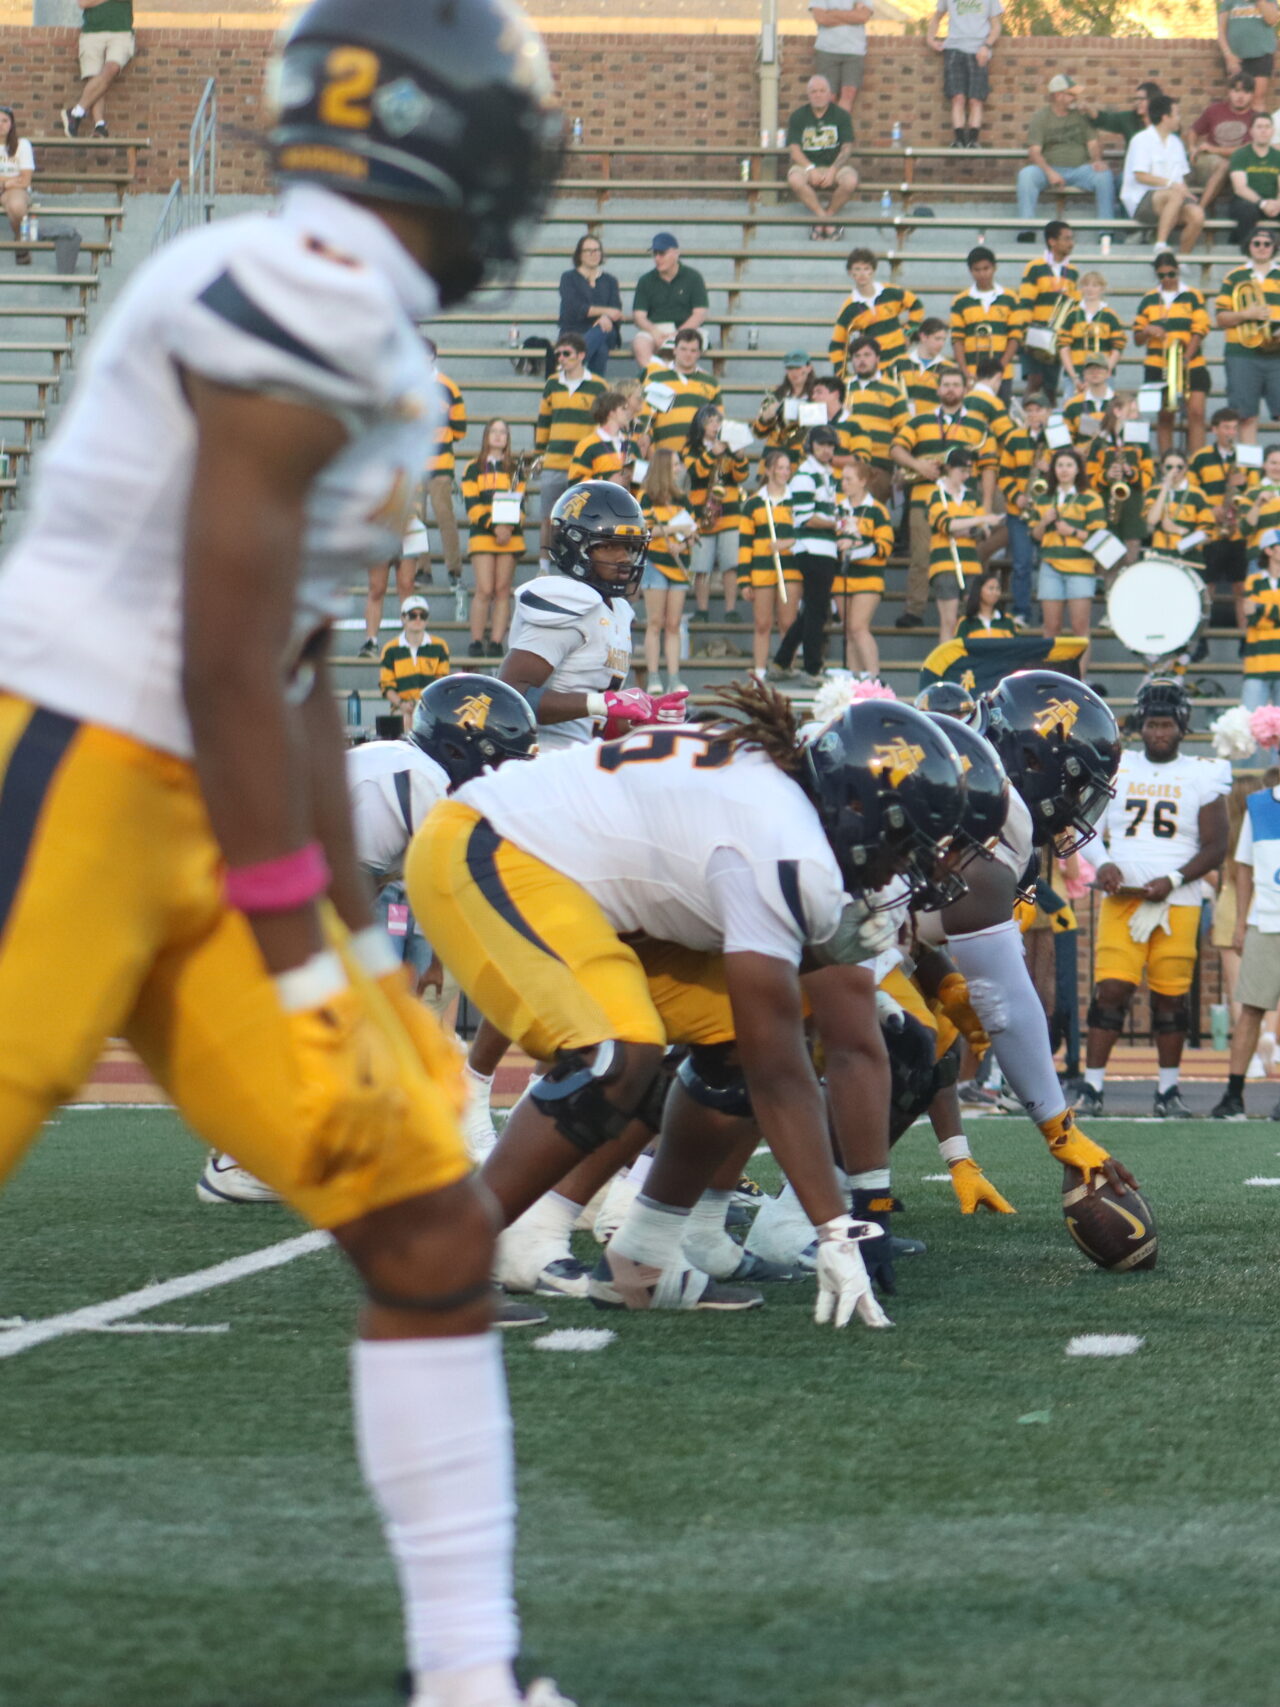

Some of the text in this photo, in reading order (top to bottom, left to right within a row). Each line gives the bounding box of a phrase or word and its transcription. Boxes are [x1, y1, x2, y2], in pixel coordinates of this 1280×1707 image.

[318, 45, 380, 131] 2
[1127, 782, 1182, 799] AGGIES
[1124, 798, 1178, 839] 76
